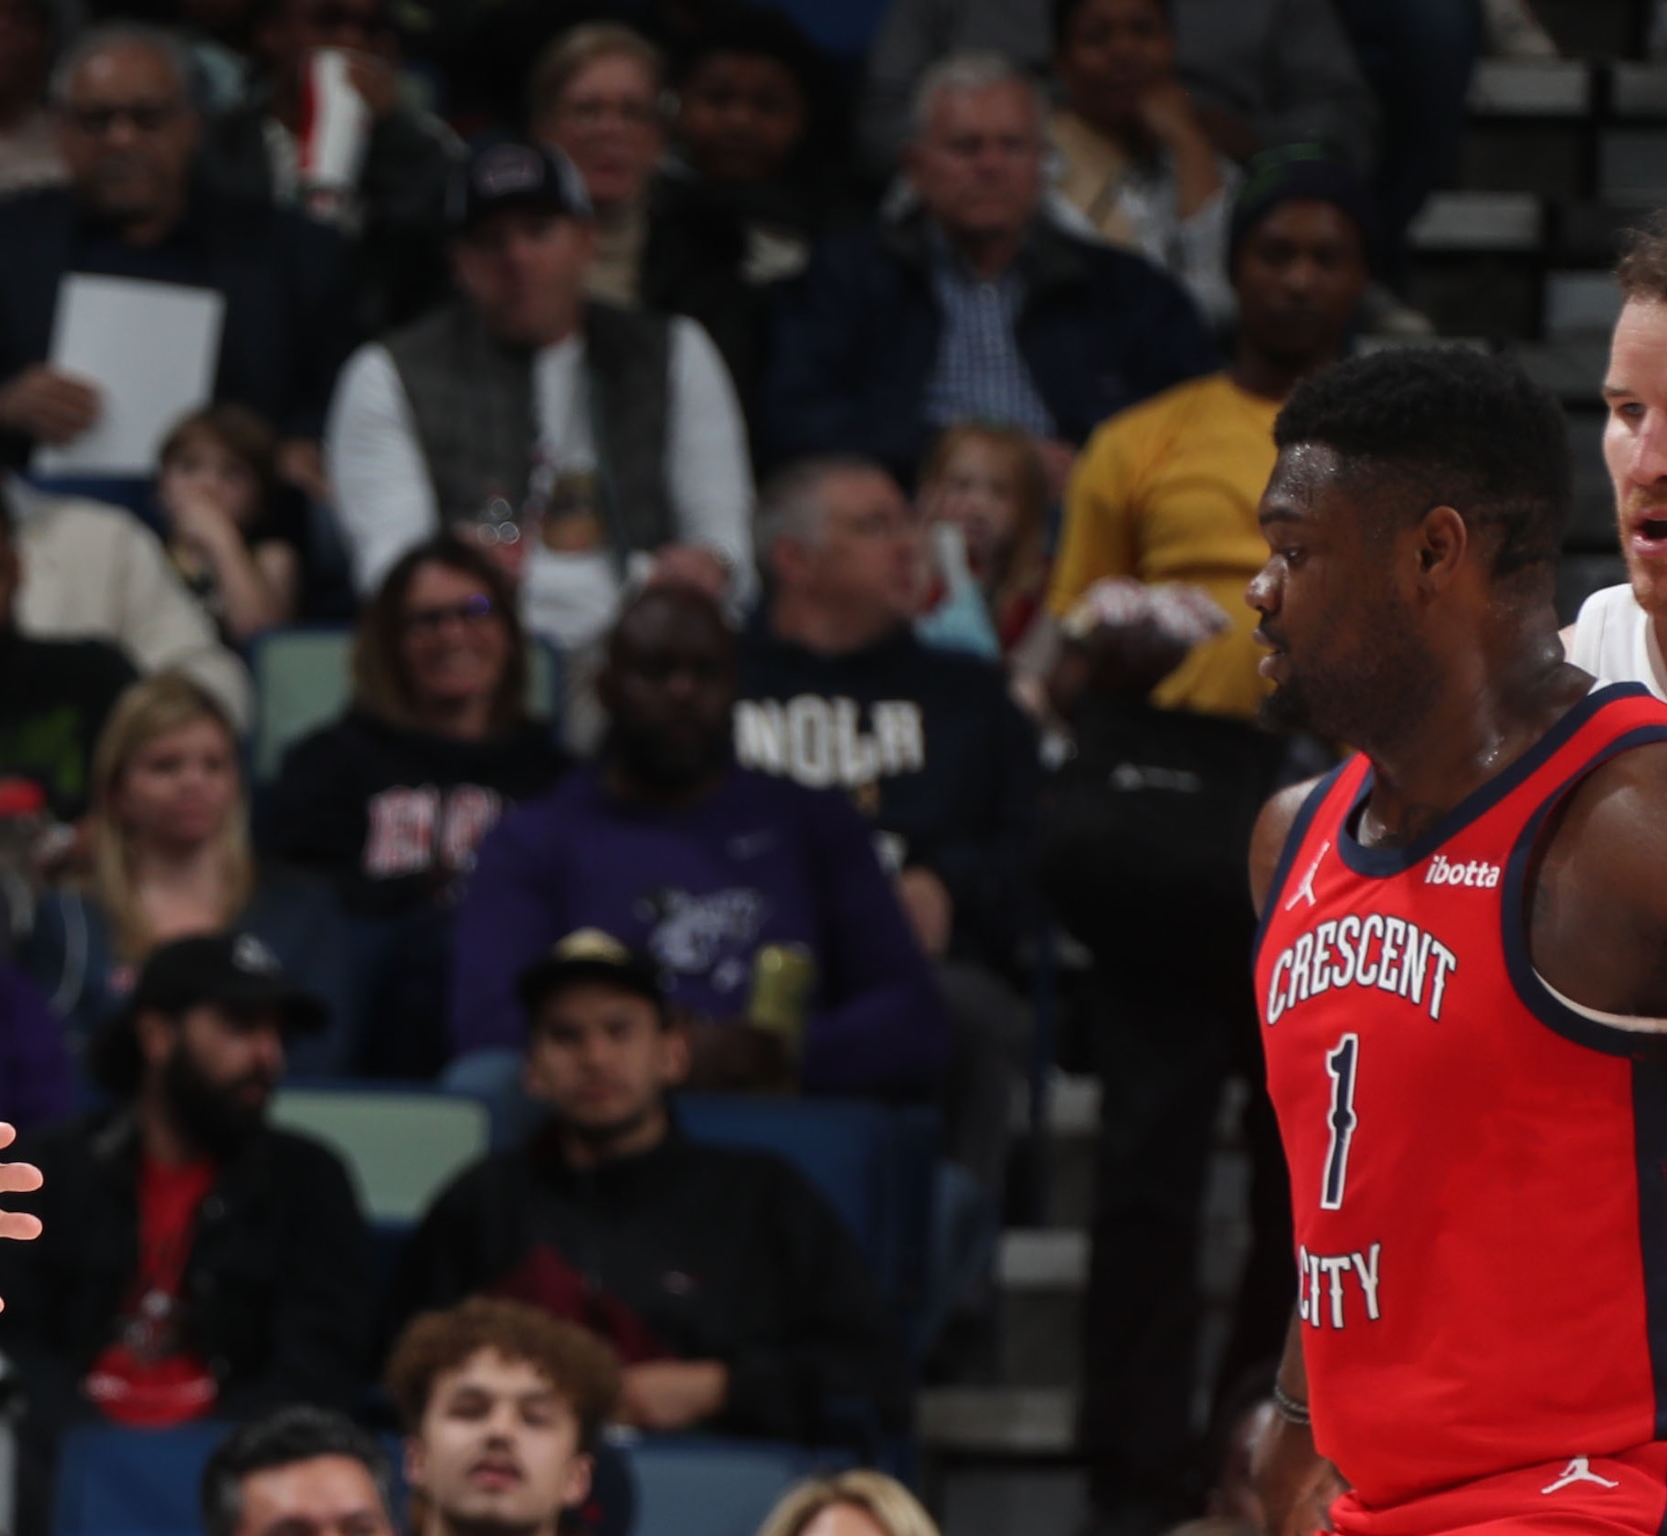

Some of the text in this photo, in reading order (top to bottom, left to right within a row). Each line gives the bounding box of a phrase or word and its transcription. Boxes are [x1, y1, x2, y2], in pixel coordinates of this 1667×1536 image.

[1424, 855, 1502, 888] ibotta
[1266, 913, 1458, 1026] CRESCENT
[1320, 1033, 1359, 1210] 1
[1299, 1243, 1381, 1329] CITY
